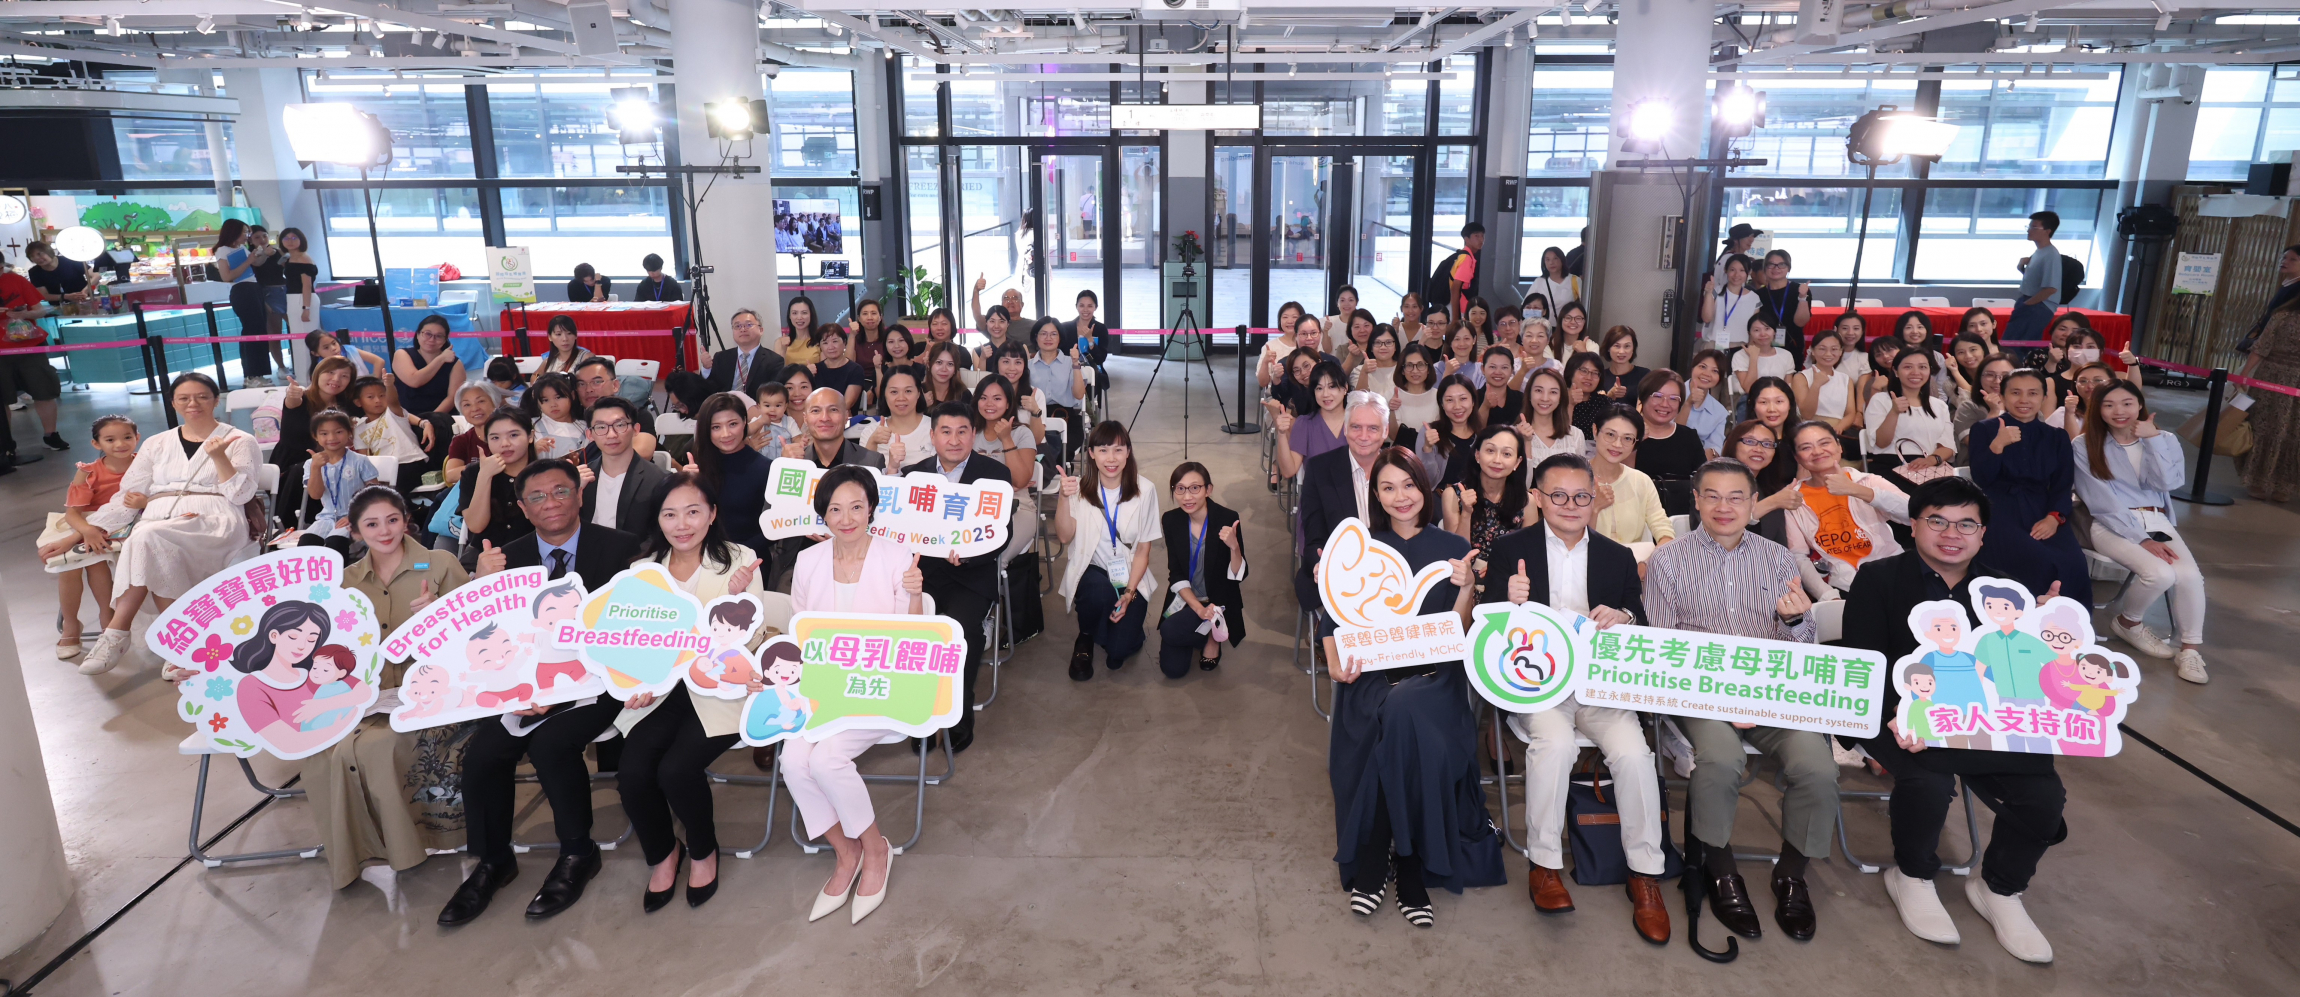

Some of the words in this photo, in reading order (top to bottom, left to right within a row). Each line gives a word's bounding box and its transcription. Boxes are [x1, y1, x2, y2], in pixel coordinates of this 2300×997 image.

[909, 182, 939, 191] FREEZ
[961, 182, 983, 191] RIED
[776, 467, 1003, 522] 國乳哺育周
[771, 514, 811, 530] World
[910, 532, 946, 545] Week
[951, 524, 995, 546] 2025
[1853, 542, 1872, 552] HEAR
[156, 555, 333, 656] 給寶寶最好的
[386, 570, 542, 658] Breastfeeding
[608, 604, 678, 620] Prioritise
[417, 630, 450, 659] for
[451, 593, 527, 634] Health
[558, 625, 711, 654] Breastfeeding
[1341, 619, 1456, 649] 愛嬰母嬰健康院
[804, 635, 962, 674] 以母乳餵哺
[1430, 643, 1465, 656] MCHC
[1590, 630, 1876, 690] 優先考慮母乳哺育
[847, 676, 888, 697] 為先
[1587, 662, 1693, 693] Prioritise
[1698, 675, 1871, 717] Breastfeeding
[1585, 687, 1679, 709] 建立永續支持系統
[1681, 699, 1715, 714] Create
[1716, 704, 1778, 720] sustainable
[1779, 713, 1824, 727] support
[1825, 718, 1870, 731] systems
[1929, 705, 2097, 742] 家人支持你
